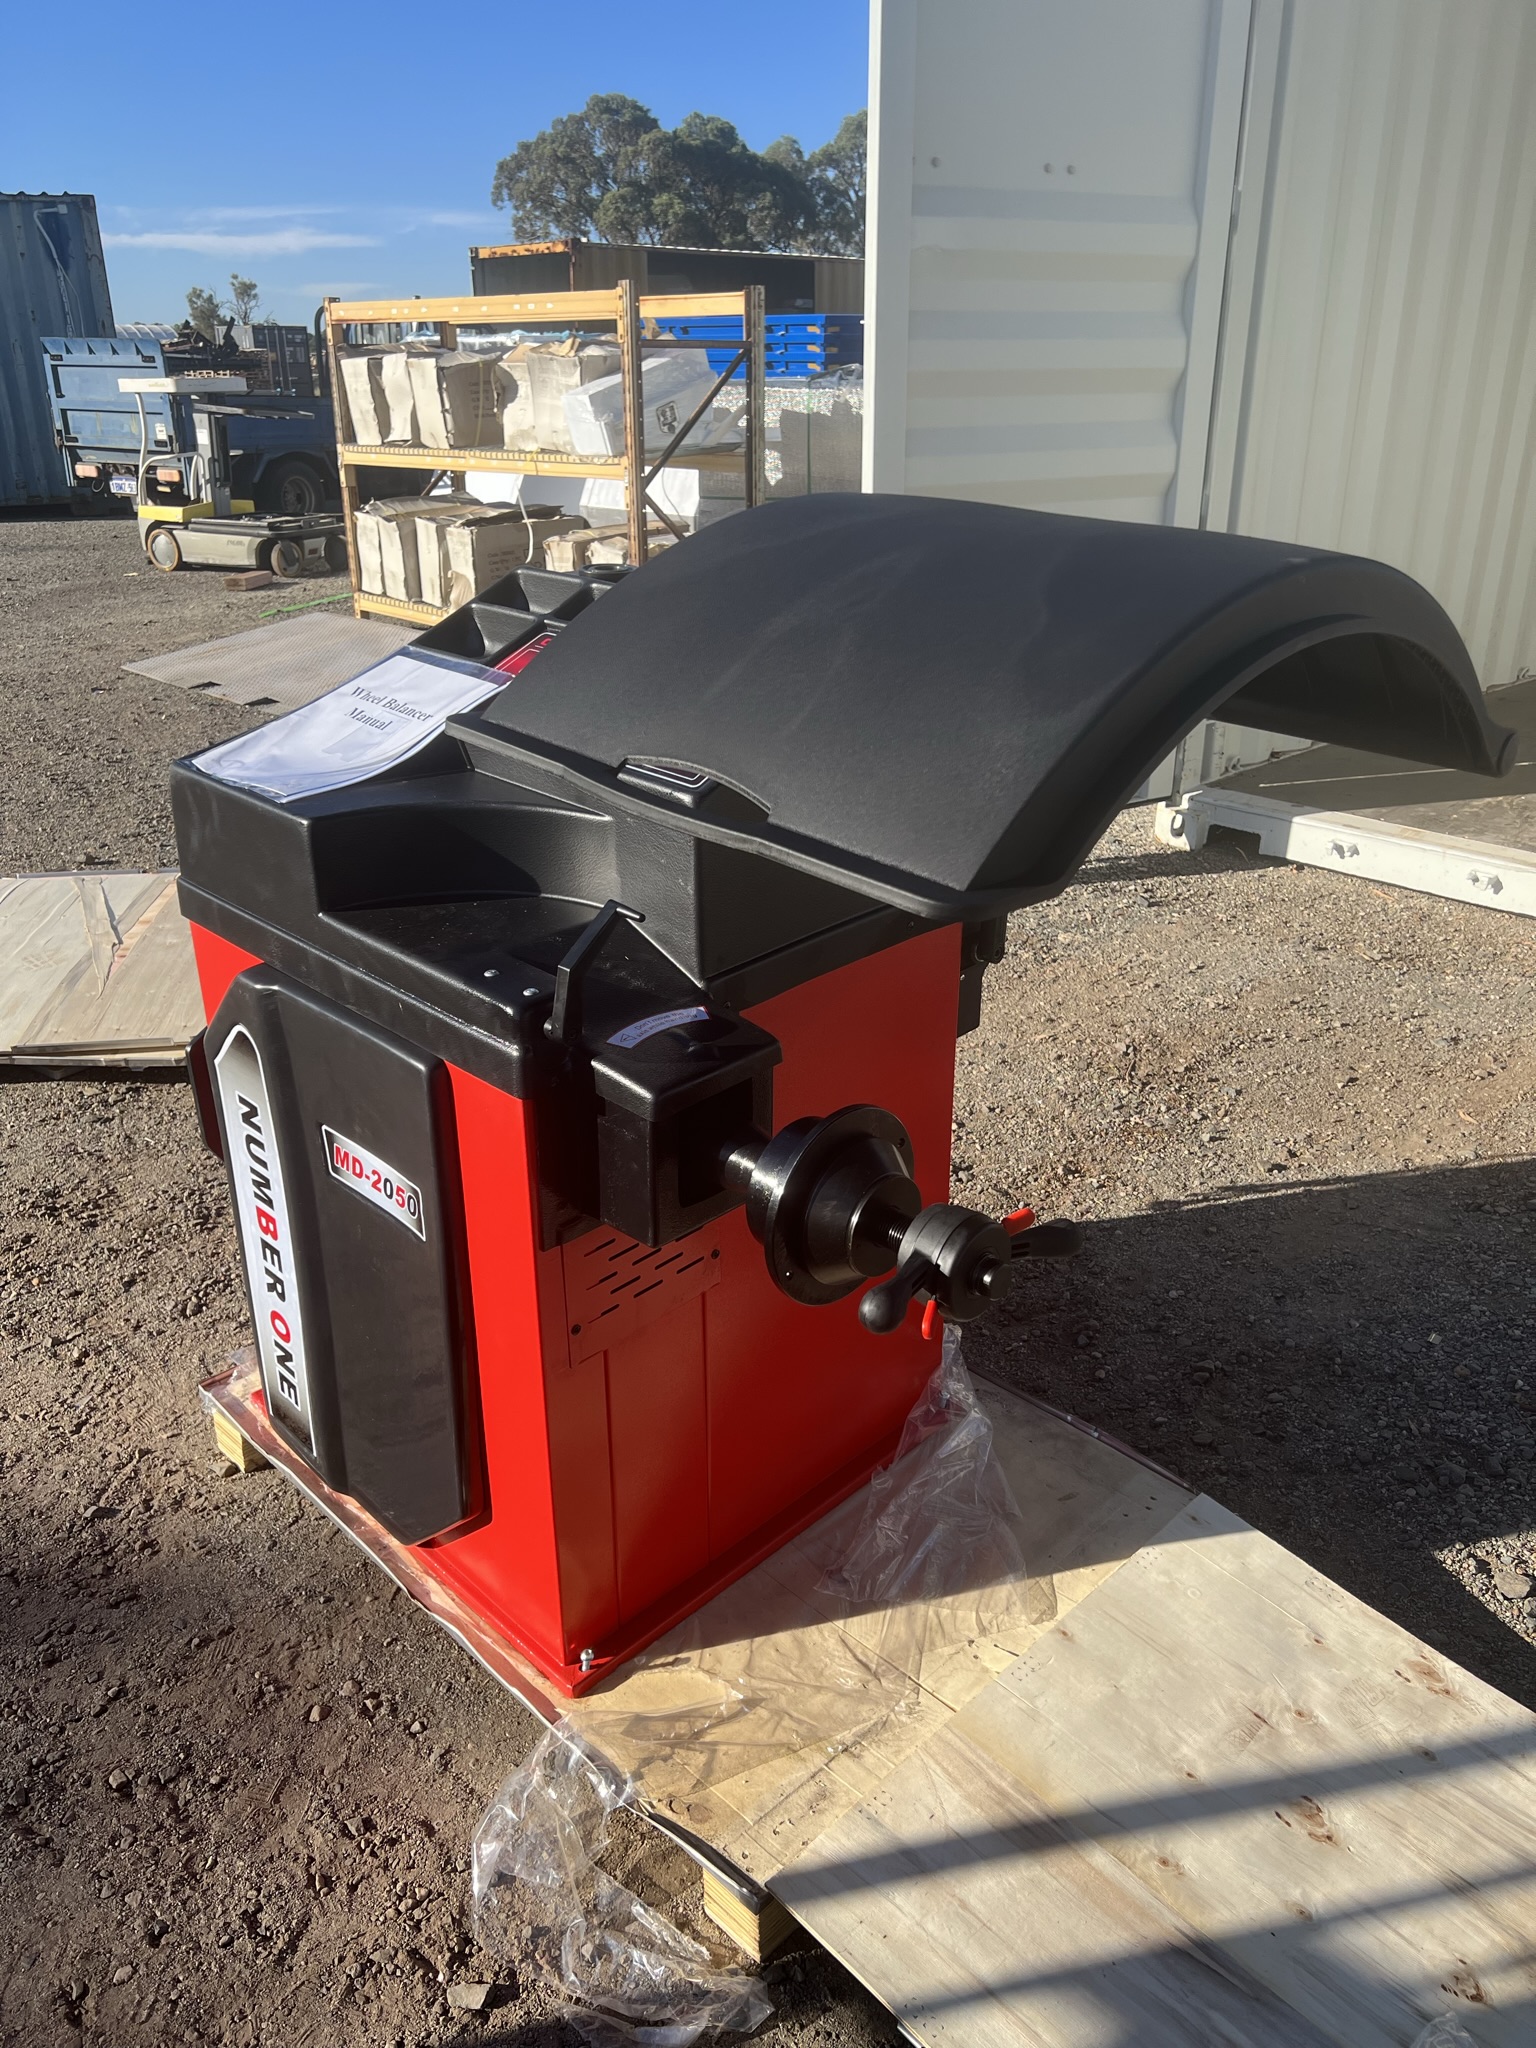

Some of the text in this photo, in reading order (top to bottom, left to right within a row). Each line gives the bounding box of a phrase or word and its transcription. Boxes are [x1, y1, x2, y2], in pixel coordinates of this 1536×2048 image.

[344, 707, 393, 731] Manual
[350, 686, 434, 722] Wheel Balancer
[334, 1143, 418, 1219] MD-2050
[236, 1092, 301, 1409] NUMBER ONE
